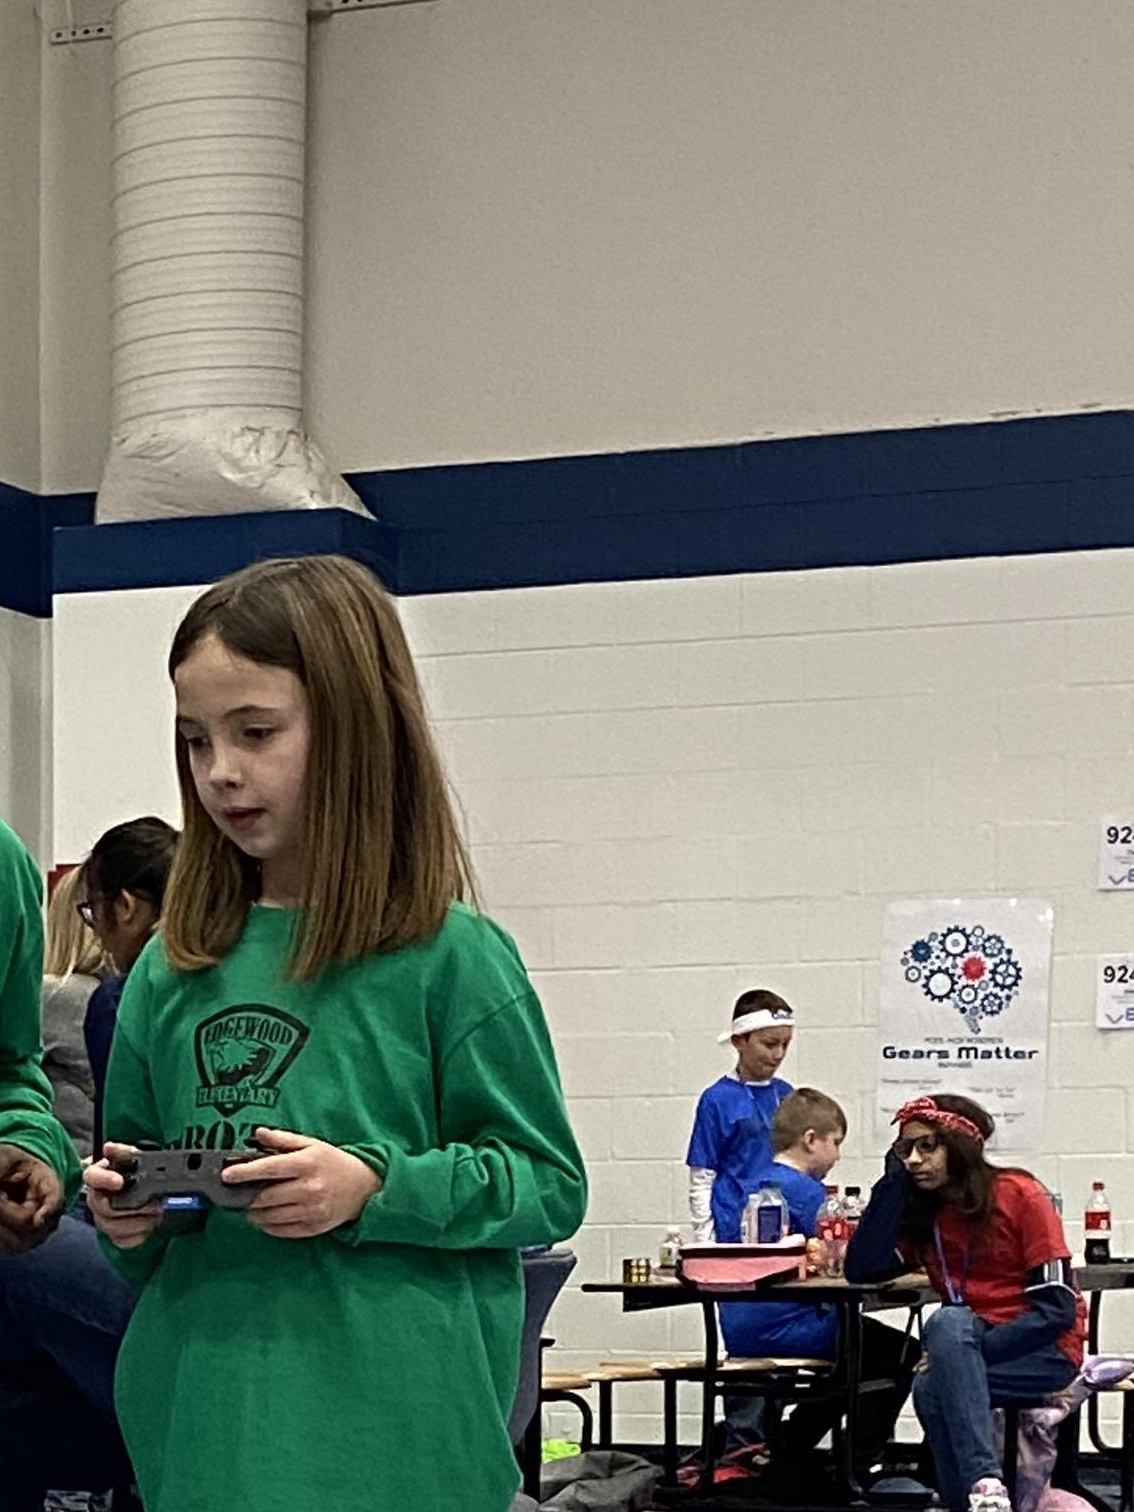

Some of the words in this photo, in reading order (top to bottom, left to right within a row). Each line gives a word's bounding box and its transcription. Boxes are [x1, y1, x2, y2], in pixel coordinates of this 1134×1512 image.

[1106, 826, 1134, 844] 92
[204, 1016, 294, 1045] EDGEWOOD
[882, 1046, 950, 1060] Gears
[958, 1046, 1039, 1060] Matter
